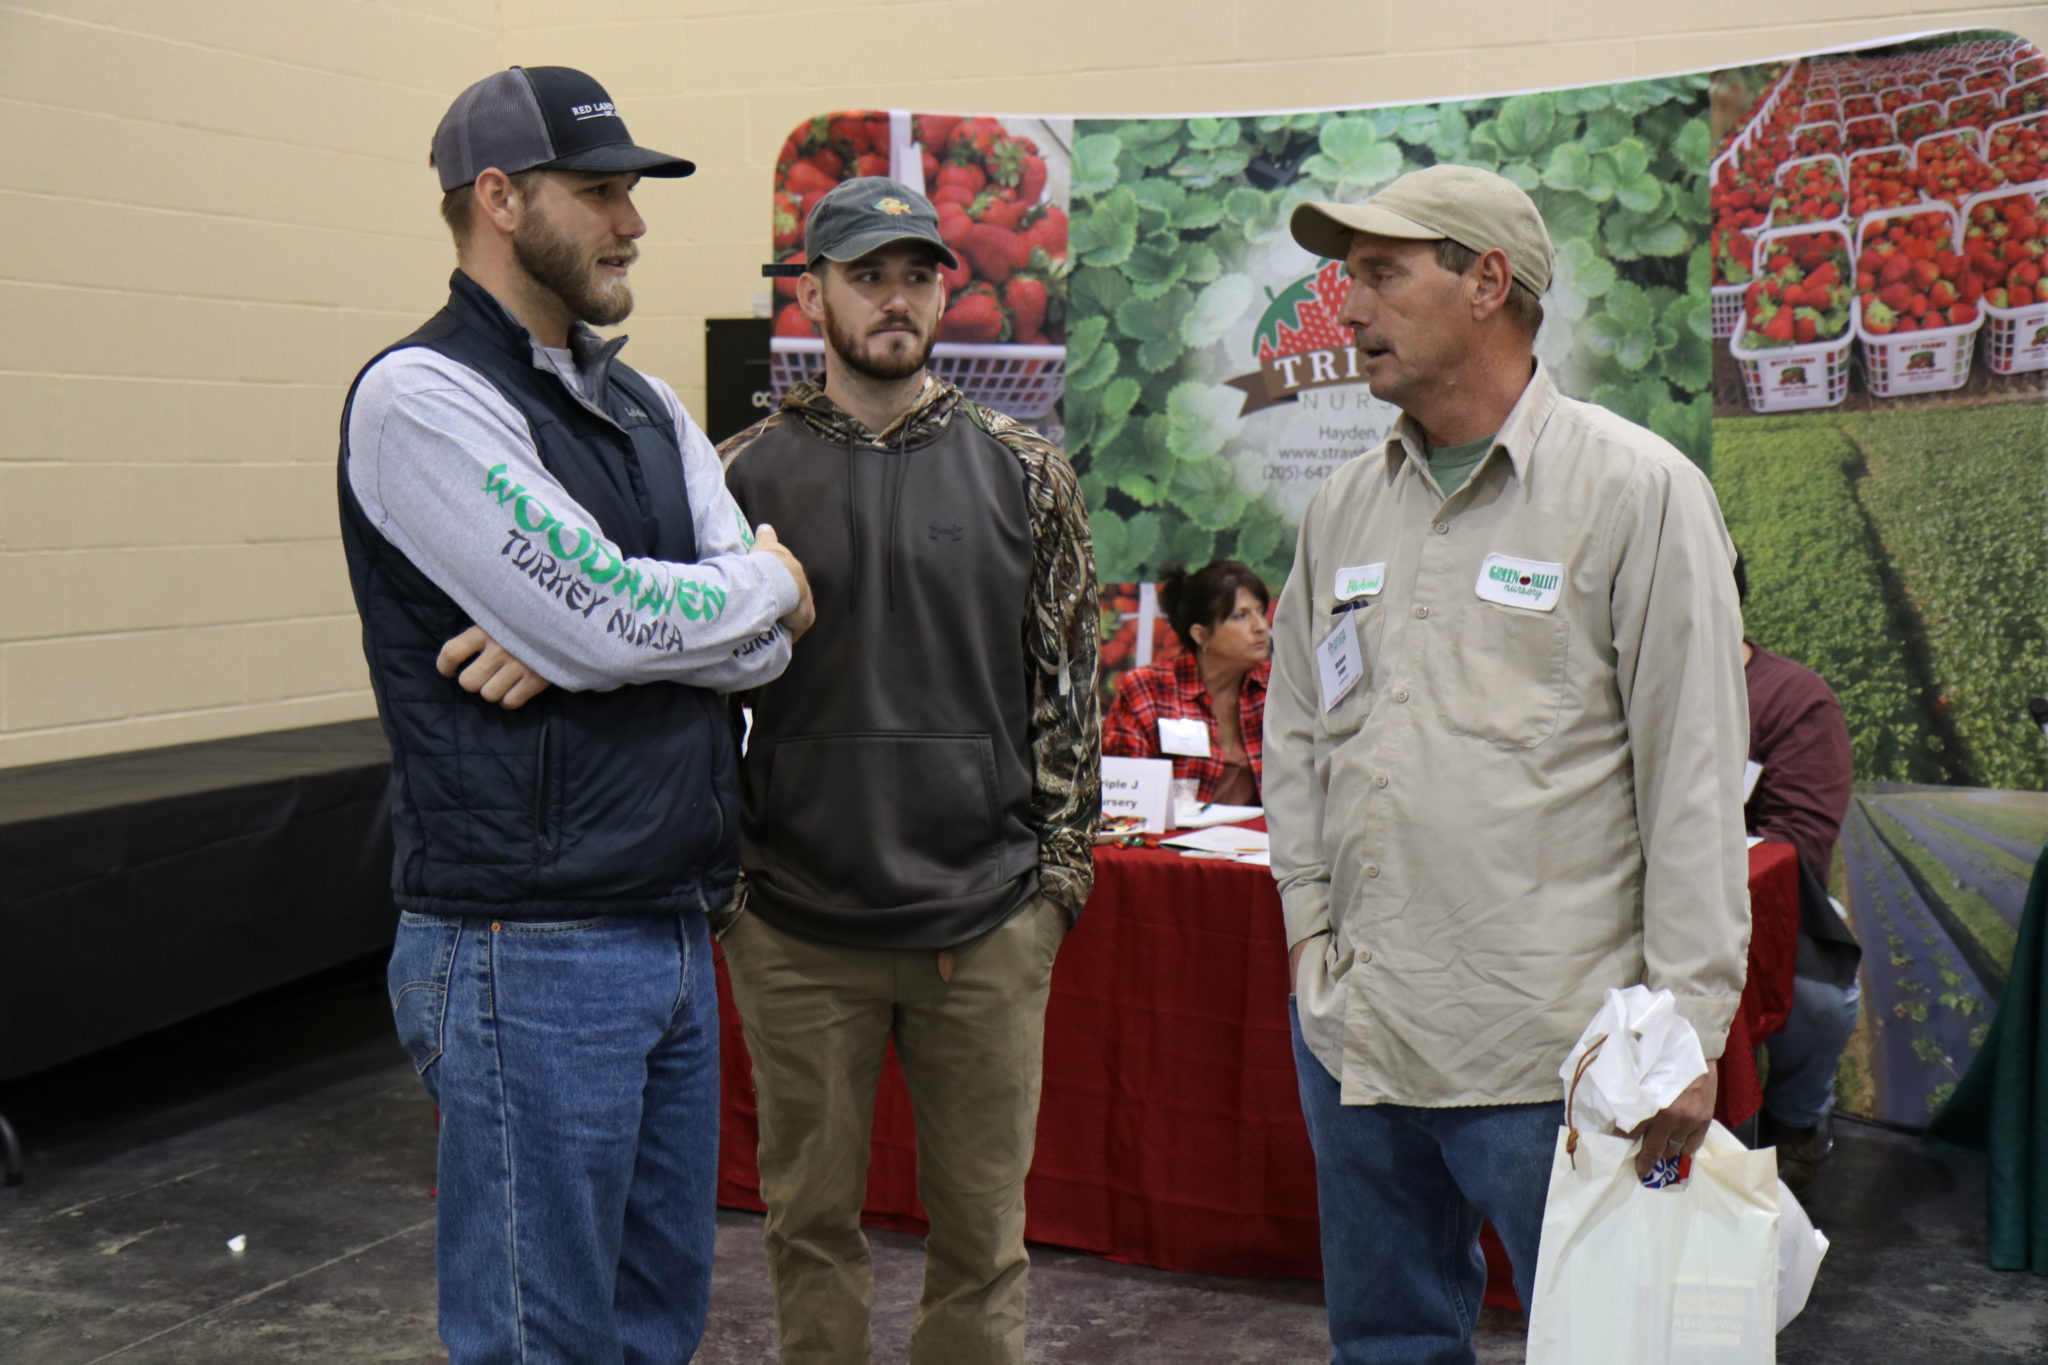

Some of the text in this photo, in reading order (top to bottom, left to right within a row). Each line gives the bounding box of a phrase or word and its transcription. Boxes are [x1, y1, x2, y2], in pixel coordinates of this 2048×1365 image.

[571, 104, 592, 116] RED
[1319, 425, 1380, 442] Hayden,
[481, 463, 727, 622] WOODHAVEN
[501, 528, 609, 619] TURKEY
[607, 608, 685, 652] NINJA
[1131, 780, 1138, 790] J
